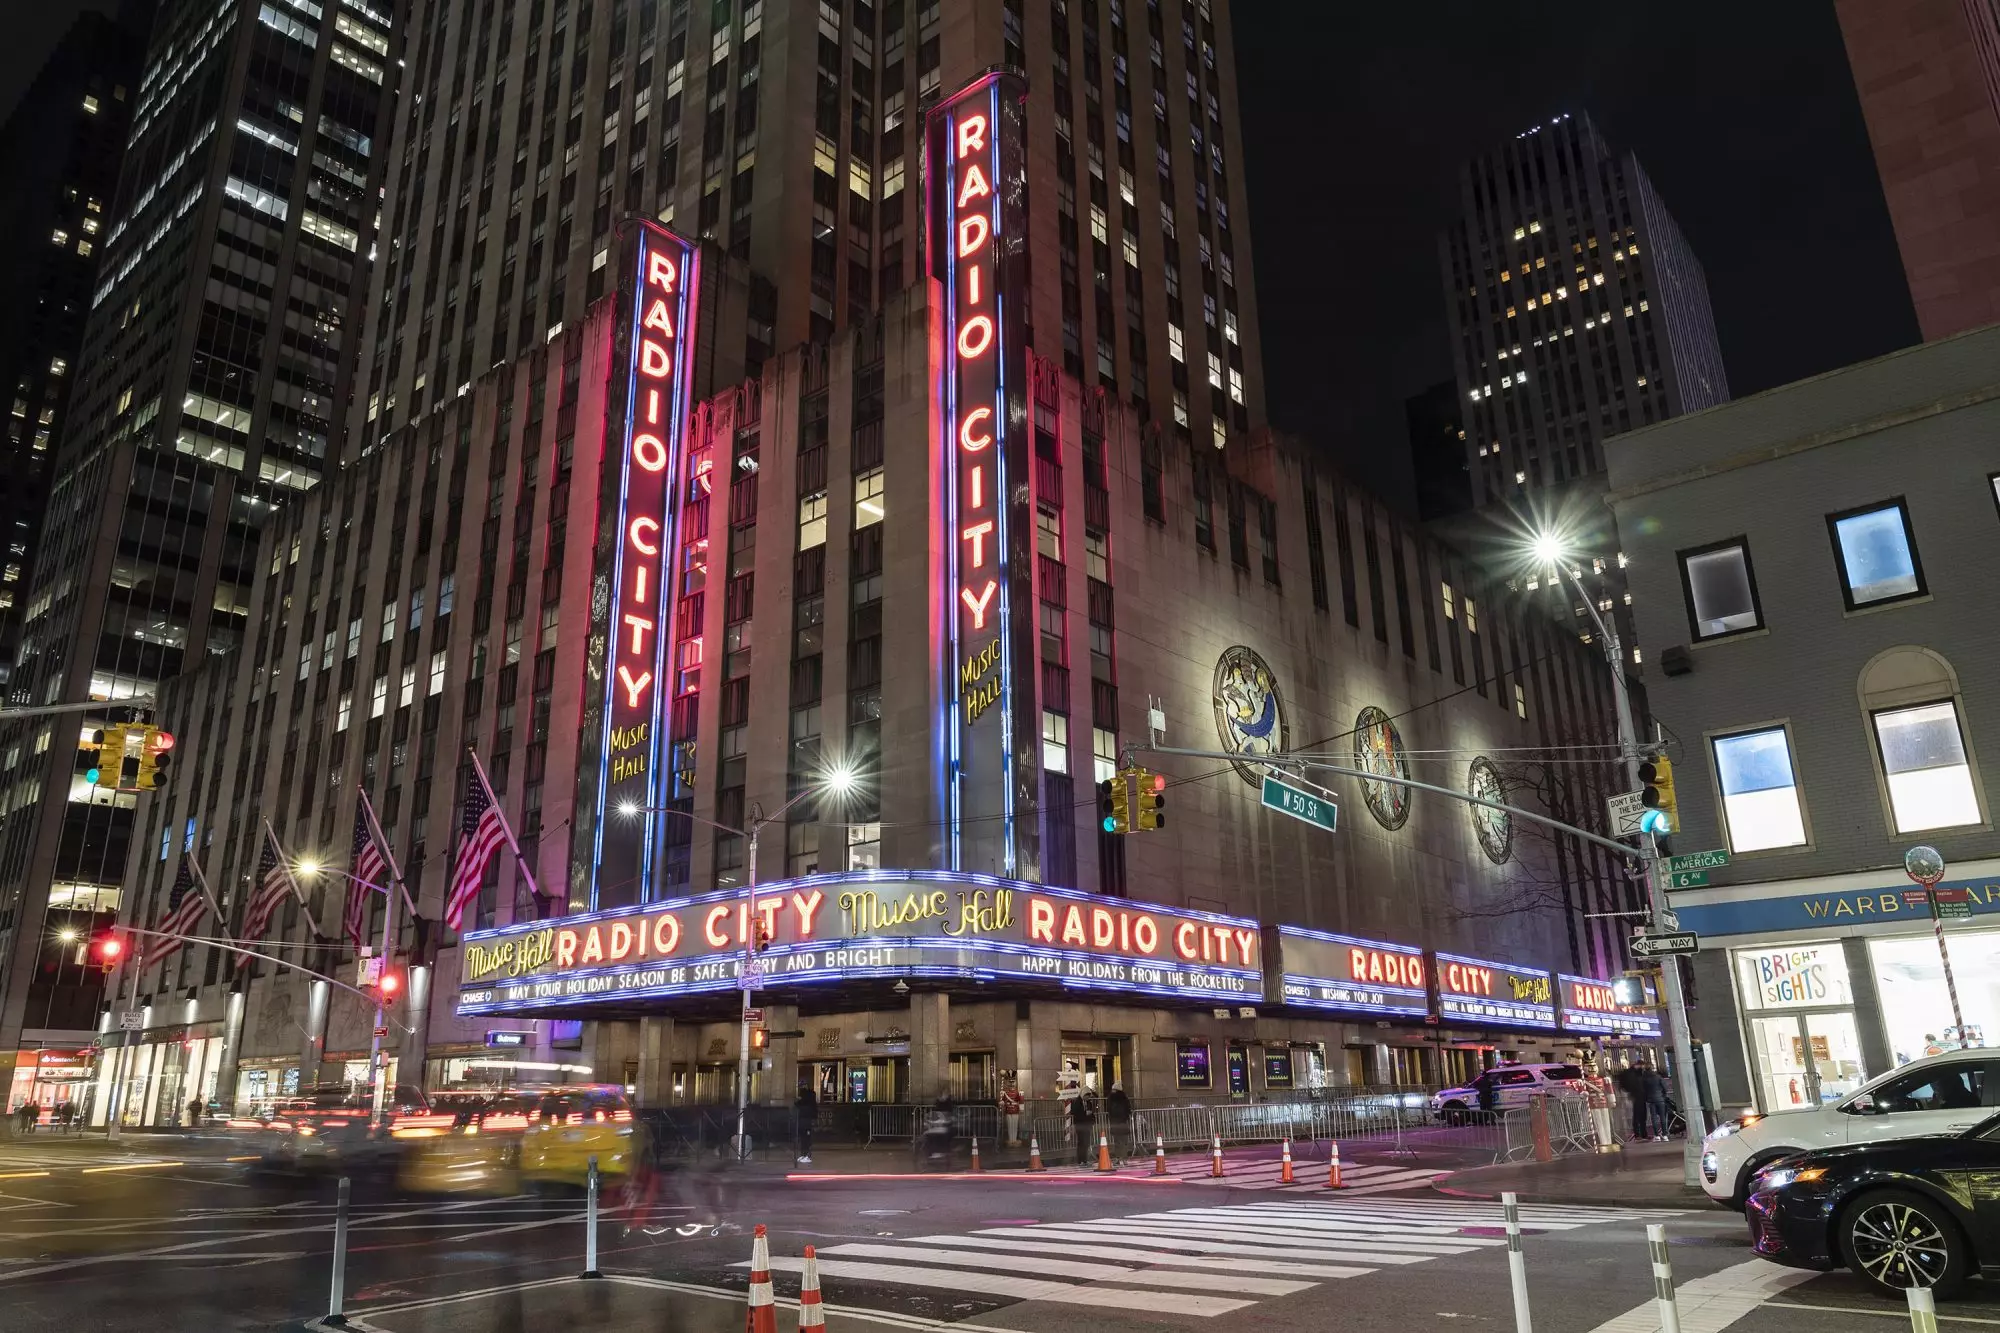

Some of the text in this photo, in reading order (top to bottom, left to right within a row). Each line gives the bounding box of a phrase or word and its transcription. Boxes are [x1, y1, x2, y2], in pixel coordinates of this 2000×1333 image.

[957, 115, 997, 629] RADIO CITY
[617, 251, 676, 708] RADIO CITY
[960, 638, 1001, 694] MUSIC
[967, 675, 1002, 726] HALL
[610, 722, 649, 755] MUSIC
[613, 754, 647, 784] HALL
[1283, 790, 1317, 819] W 50 St
[1610, 793, 1642, 808] DON'T BLO
[1618, 805, 1631, 815] THE
[1674, 855, 1726, 870] AMERICAS
[1680, 874, 1690, 886] 6
[465, 888, 1255, 981] Music Hall RADIO CITY Music Hall RADIO CITY
[1636, 937, 1691, 951] ONE WAY
[508, 985, 530, 1000] MAY
[535, 980, 561, 997] YOUR
[566, 976, 612, 994] HOLIDAY
[618, 970, 665, 989] SEASON
[671, 968, 686, 984] BE
[694, 963, 729, 981] SAFE.
[786, 953, 815, 971] AND
[825, 948, 894, 968] BRIGHT
[1022, 955, 1245, 992] HAPPY HOLIDAYS FROM THE ROCKETTES
[1350, 948, 1422, 986] RADIO
[1448, 964, 1491, 996] CITY
[1760, 950, 1818, 983] BRIGHT
[1767, 963, 1826, 1002] SIGHTS
[462, 992, 485, 1003] CHASE
[1284, 984, 1305, 996] CHASE
[1321, 987, 1384, 1005] WISHING YOU JOY
[1573, 983, 1616, 1012] RADIO
